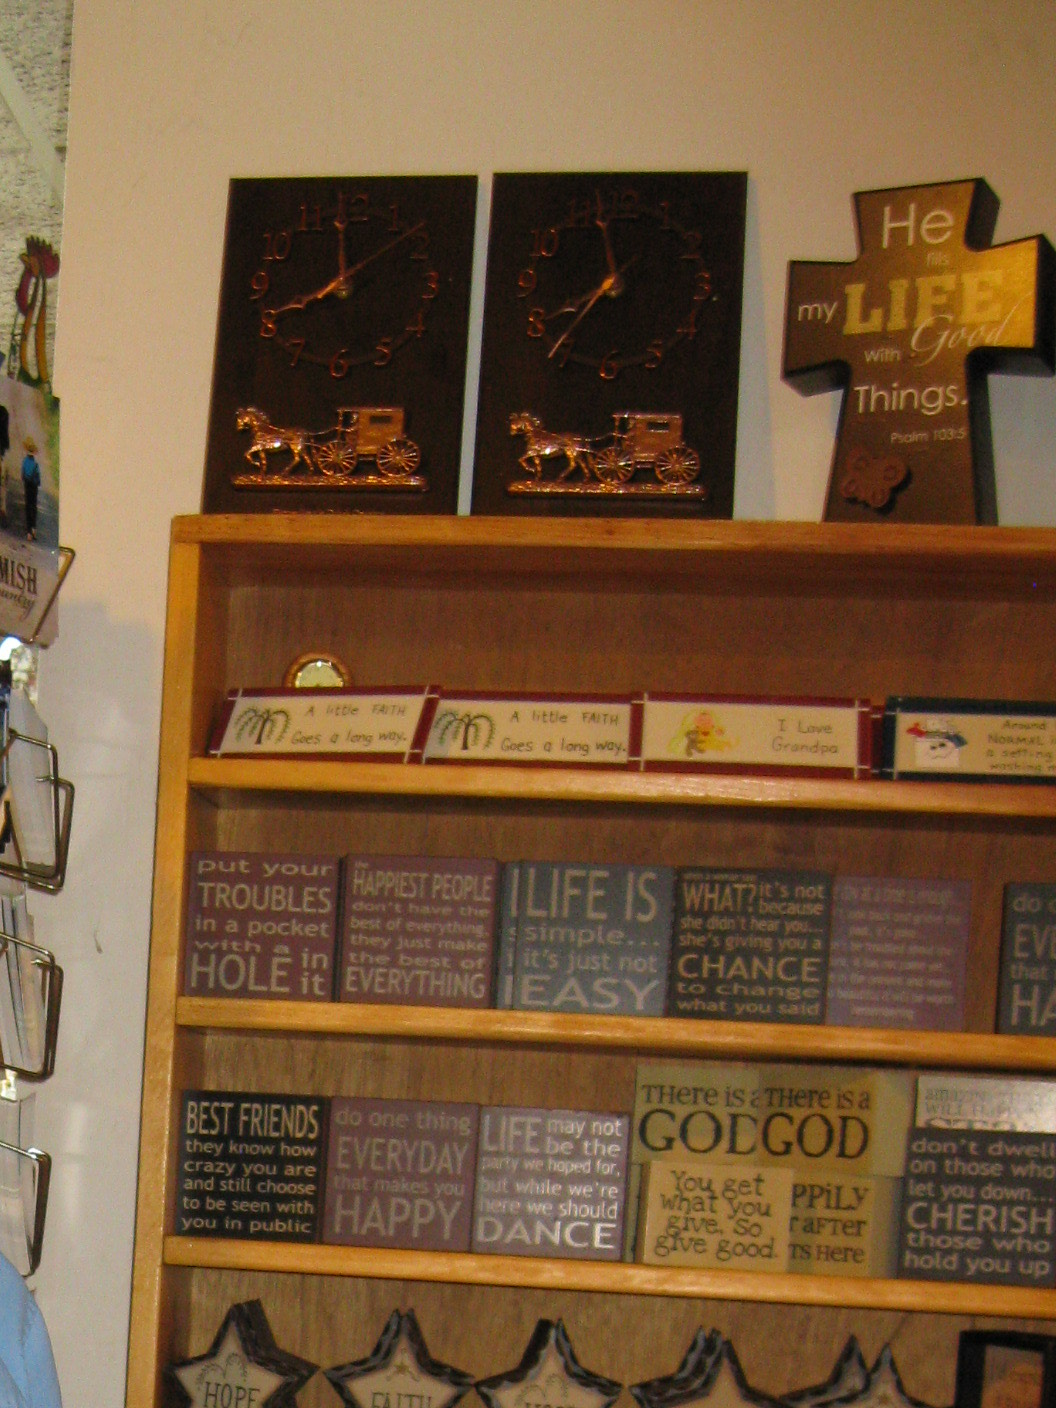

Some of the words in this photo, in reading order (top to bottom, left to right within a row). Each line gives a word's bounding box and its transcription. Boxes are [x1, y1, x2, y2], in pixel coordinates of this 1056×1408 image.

[882, 203, 955, 249] He
[798, 301, 838, 324] my
[844, 270, 1003, 335] LIFE
[864, 348, 901, 364] with
[910, 292, 1032, 367] Good
[853, 383, 968, 416] Things.
[890, 432, 929, 443] Psalm
[305, 706, 315, 716] A
[327, 704, 359, 716] little
[372, 705, 406, 716] FAITH
[509, 711, 520, 723] A
[532, 711, 568, 724] little
[582, 712, 620, 725] FAITH
[778, 719, 786, 733] I
[798, 720, 832, 734] Love
[291, 732, 322, 745] Goes
[346, 730, 372, 746] long
[379, 730, 407, 744] way.
[500, 738, 534, 752] Goes
[561, 738, 589, 755] long
[595, 739, 626, 753] way.
[772, 736, 839, 754] Grandpa
[197, 858, 250, 874] put
[263, 861, 333, 877] your
[352, 870, 429, 899] HAPPIEST
[432, 874, 493, 901] PEOPLE
[525, 867, 610, 920] LIFE
[624, 871, 658, 922] IS
[759, 881, 789, 898] it's
[794, 884, 825, 899] not
[197, 882, 332, 913] TROUBLES
[681, 882, 756, 913] WHAT?
[1013, 893, 1041, 912] do
[759, 900, 824, 916] because
[195, 915, 216, 932] in
[226, 920, 238, 934] a
[248, 919, 330, 937] pocket
[680, 917, 703, 929] she
[706, 918, 745, 930] didn't
[749, 919, 779, 933] hear
[194, 939, 262, 952] with
[679, 933, 720, 948] she's
[725, 935, 773, 951] giving
[778, 936, 807, 951] you
[812, 941, 821, 950] a
[302, 948, 329, 969] in
[349, 952, 390, 965] the
[523, 948, 558, 968] it's
[566, 952, 611, 974] just
[617, 954, 658, 973] not
[678, 954, 820, 982] CHANCE
[190, 952, 292, 993] HOLE
[301, 972, 326, 995] it
[346, 967, 485, 999] EVERYTHING
[520, 974, 660, 1010] EASY
[677, 981, 704, 994] to
[716, 983, 820, 999] change
[677, 1000, 727, 1012] what
[734, 1003, 771, 1015] you
[778, 1002, 820, 1016] said
[858, 1091, 870, 1109] a
[186, 1101, 234, 1135] BEST
[239, 1103, 319, 1140] FRIENDS
[336, 1108, 362, 1126] do
[368, 1112, 409, 1128] one
[416, 1112, 470, 1136] thing
[546, 1118, 586, 1138] may
[591, 1120, 622, 1137] not
[484, 1115, 542, 1154] LIFE
[762, 1112, 869, 1159] GOD
[186, 1140, 224, 1156] they
[228, 1142, 274, 1155] know
[280, 1142, 316, 1157] how
[336, 1136, 469, 1174] EVERYDAY
[546, 1137, 574, 1155] be
[584, 1139, 621, 1157] the
[912, 1138, 979, 1156] don't
[184, 1160, 236, 1176] crazy
[243, 1162, 277, 1176] you
[284, 1164, 316, 1177] are
[524, 1159, 544, 1170] we
[548, 1159, 591, 1176] hoped
[910, 1159, 936, 1174] on
[944, 1158, 1003, 1176] those
[184, 1178, 214, 1191] and
[219, 1178, 251, 1192] still
[257, 1180, 316, 1196] choose
[334, 1176, 368, 1192] that
[374, 1178, 428, 1194] makes
[434, 1181, 464, 1198] you
[516, 1178, 562, 1196] while
[569, 1182, 619, 1199] we're
[671, 1171, 713, 1191] You
[722, 1173, 765, 1200] get
[908, 1180, 935, 1197] let
[940, 1184, 975, 1199] you
[184, 1198, 200, 1210] to
[206, 1198, 226, 1211] be
[232, 1201, 270, 1212] seen
[276, 1200, 314, 1214] with
[527, 1201, 553, 1215] we
[559, 1199, 618, 1219] should
[660, 1193, 718, 1214] what
[727, 1200, 772, 1219] you
[182, 1218, 217, 1232] you
[225, 1216, 242, 1230] in
[249, 1220, 311, 1234] public
[334, 1196, 462, 1240] HAPPY
[733, 1218, 762, 1237] So
[906, 1202, 1054, 1234] CHERISH
[477, 1217, 617, 1248] DANCE
[907, 1231, 983, 1250] those
[993, 1236, 1050, 1253] who
[654, 1235, 706, 1257] give
[904, 1251, 958, 1270] hold
[966, 1256, 1011, 1276] you
[1018, 1258, 1050, 1279] up
